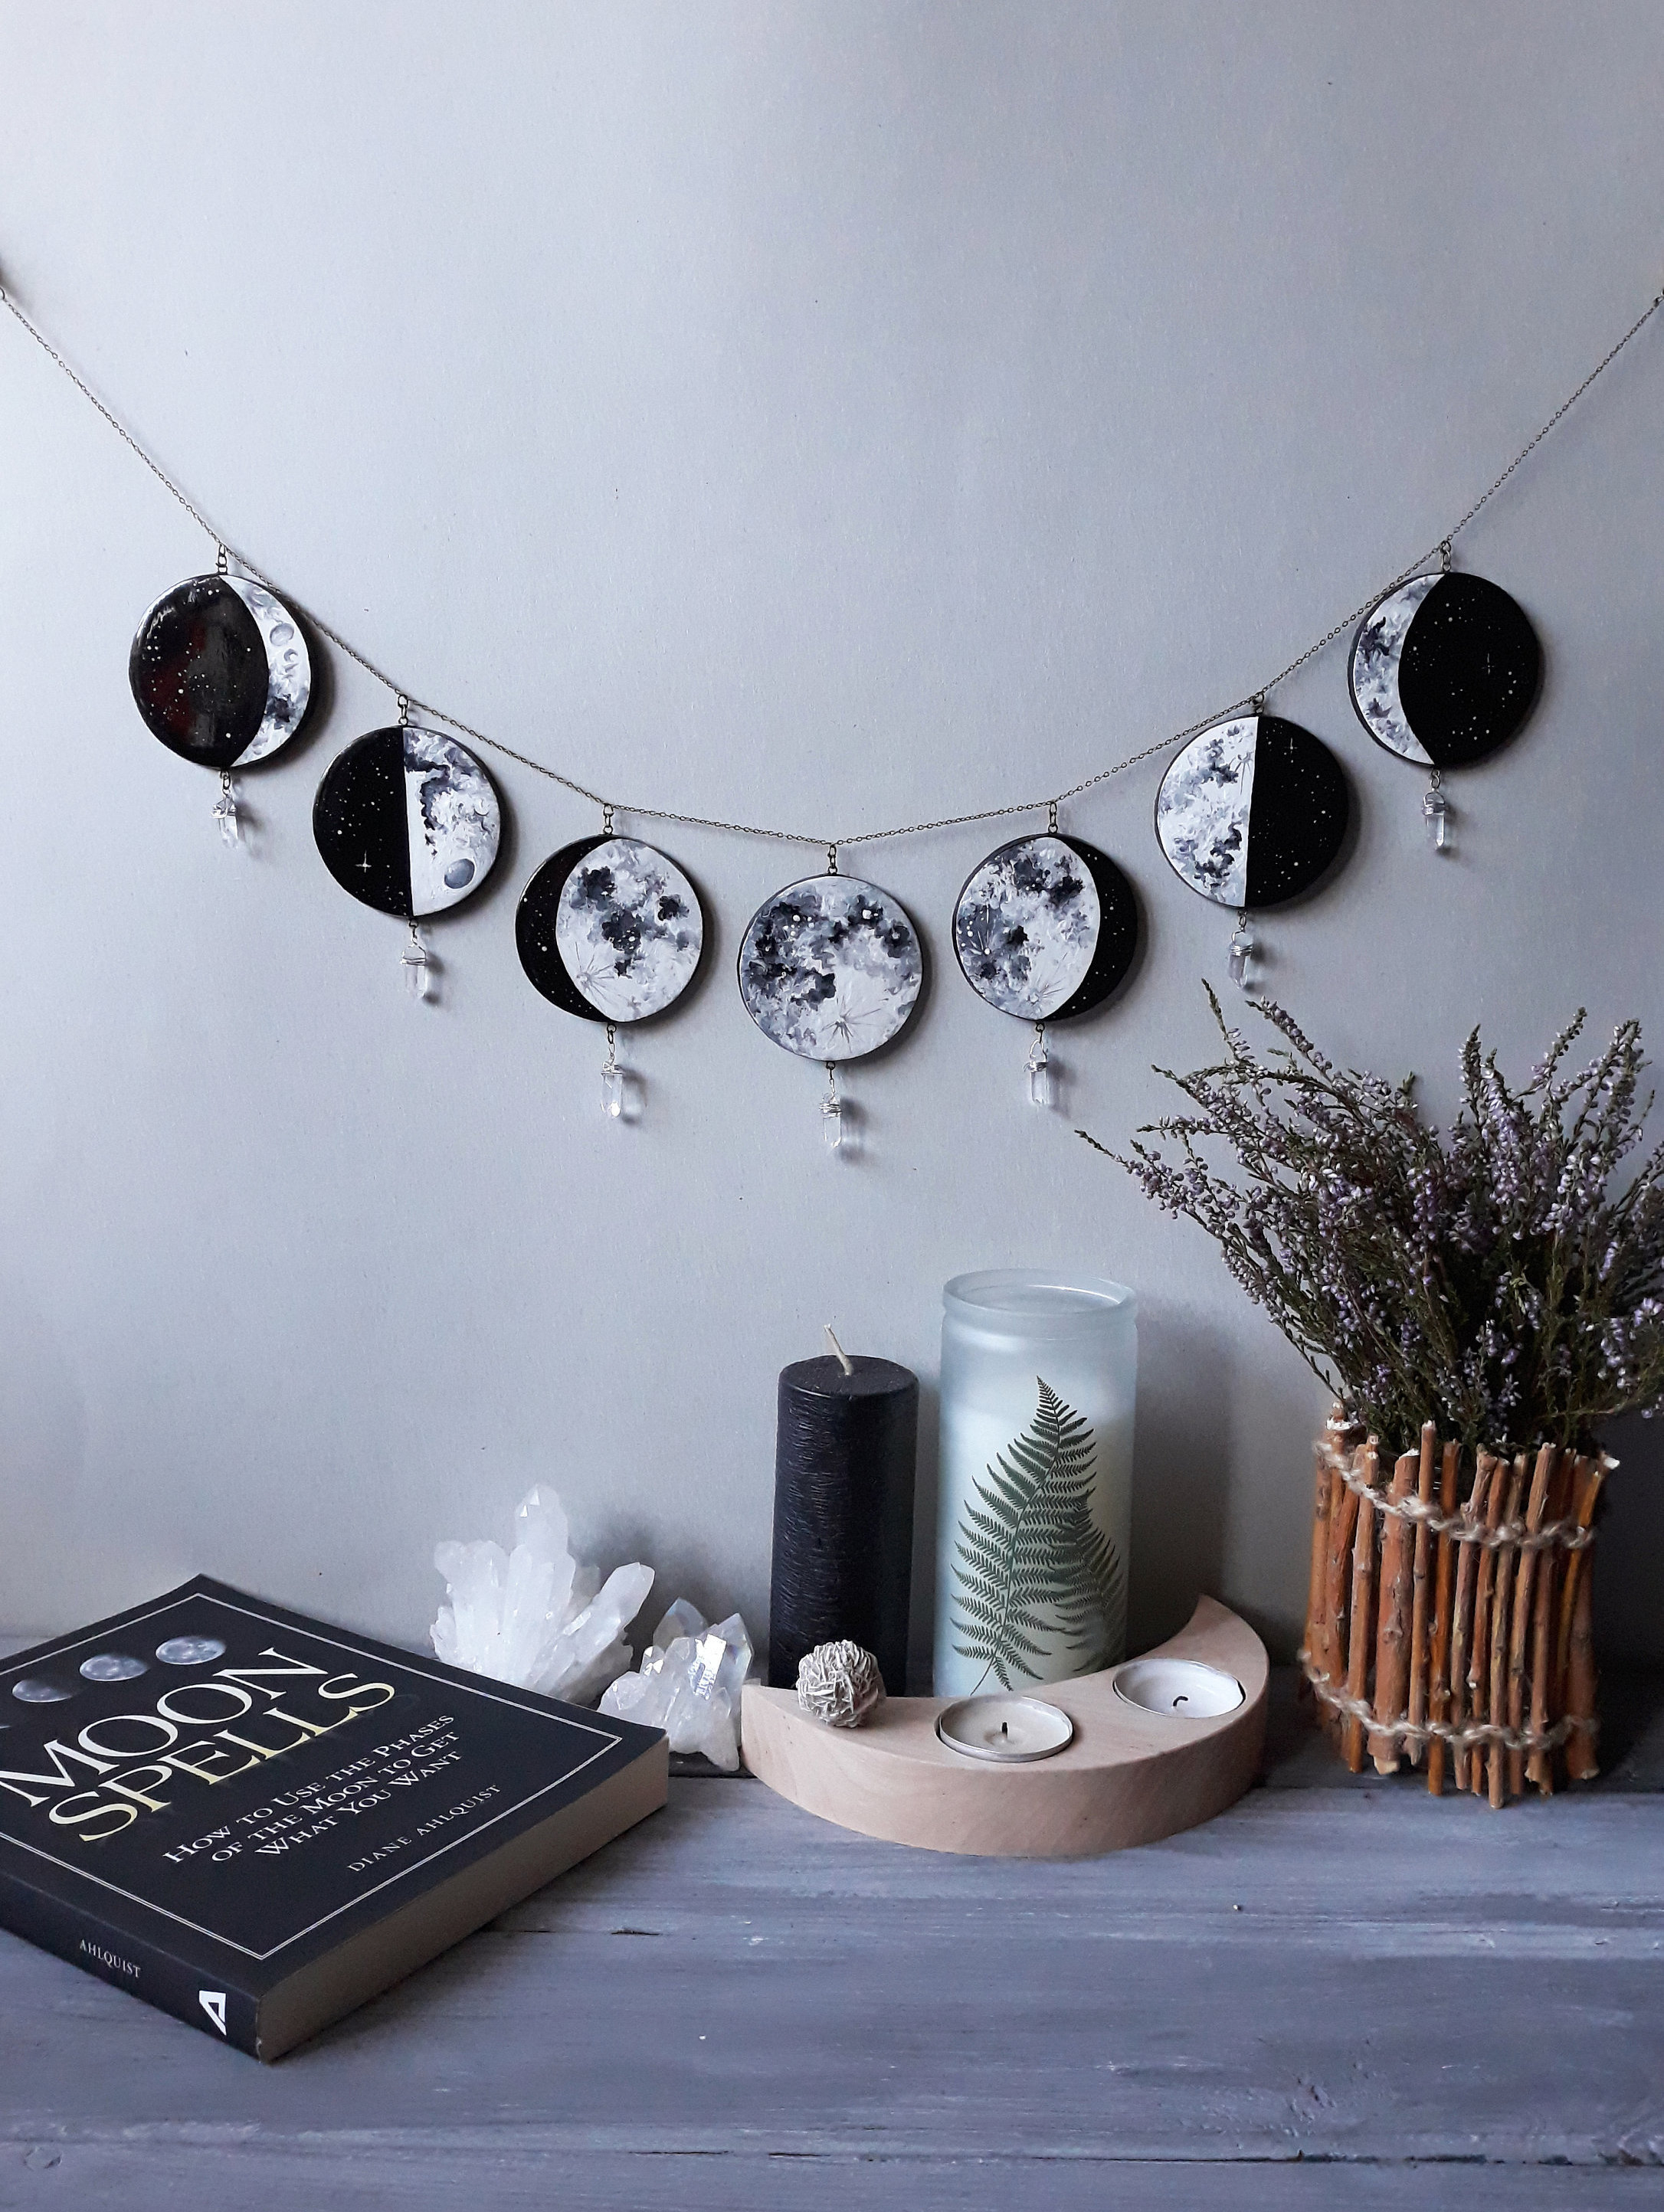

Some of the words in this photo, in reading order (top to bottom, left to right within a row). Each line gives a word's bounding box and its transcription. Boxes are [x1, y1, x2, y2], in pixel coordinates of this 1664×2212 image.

[0, 1647, 329, 1807] MOON
[48, 1672, 395, 1841] SPELLS
[347, 1836, 412, 1872] DIANE
[416, 1784, 501, 1836] AHLQUIST
[79, 1939, 141, 1978] AHLQUIST
